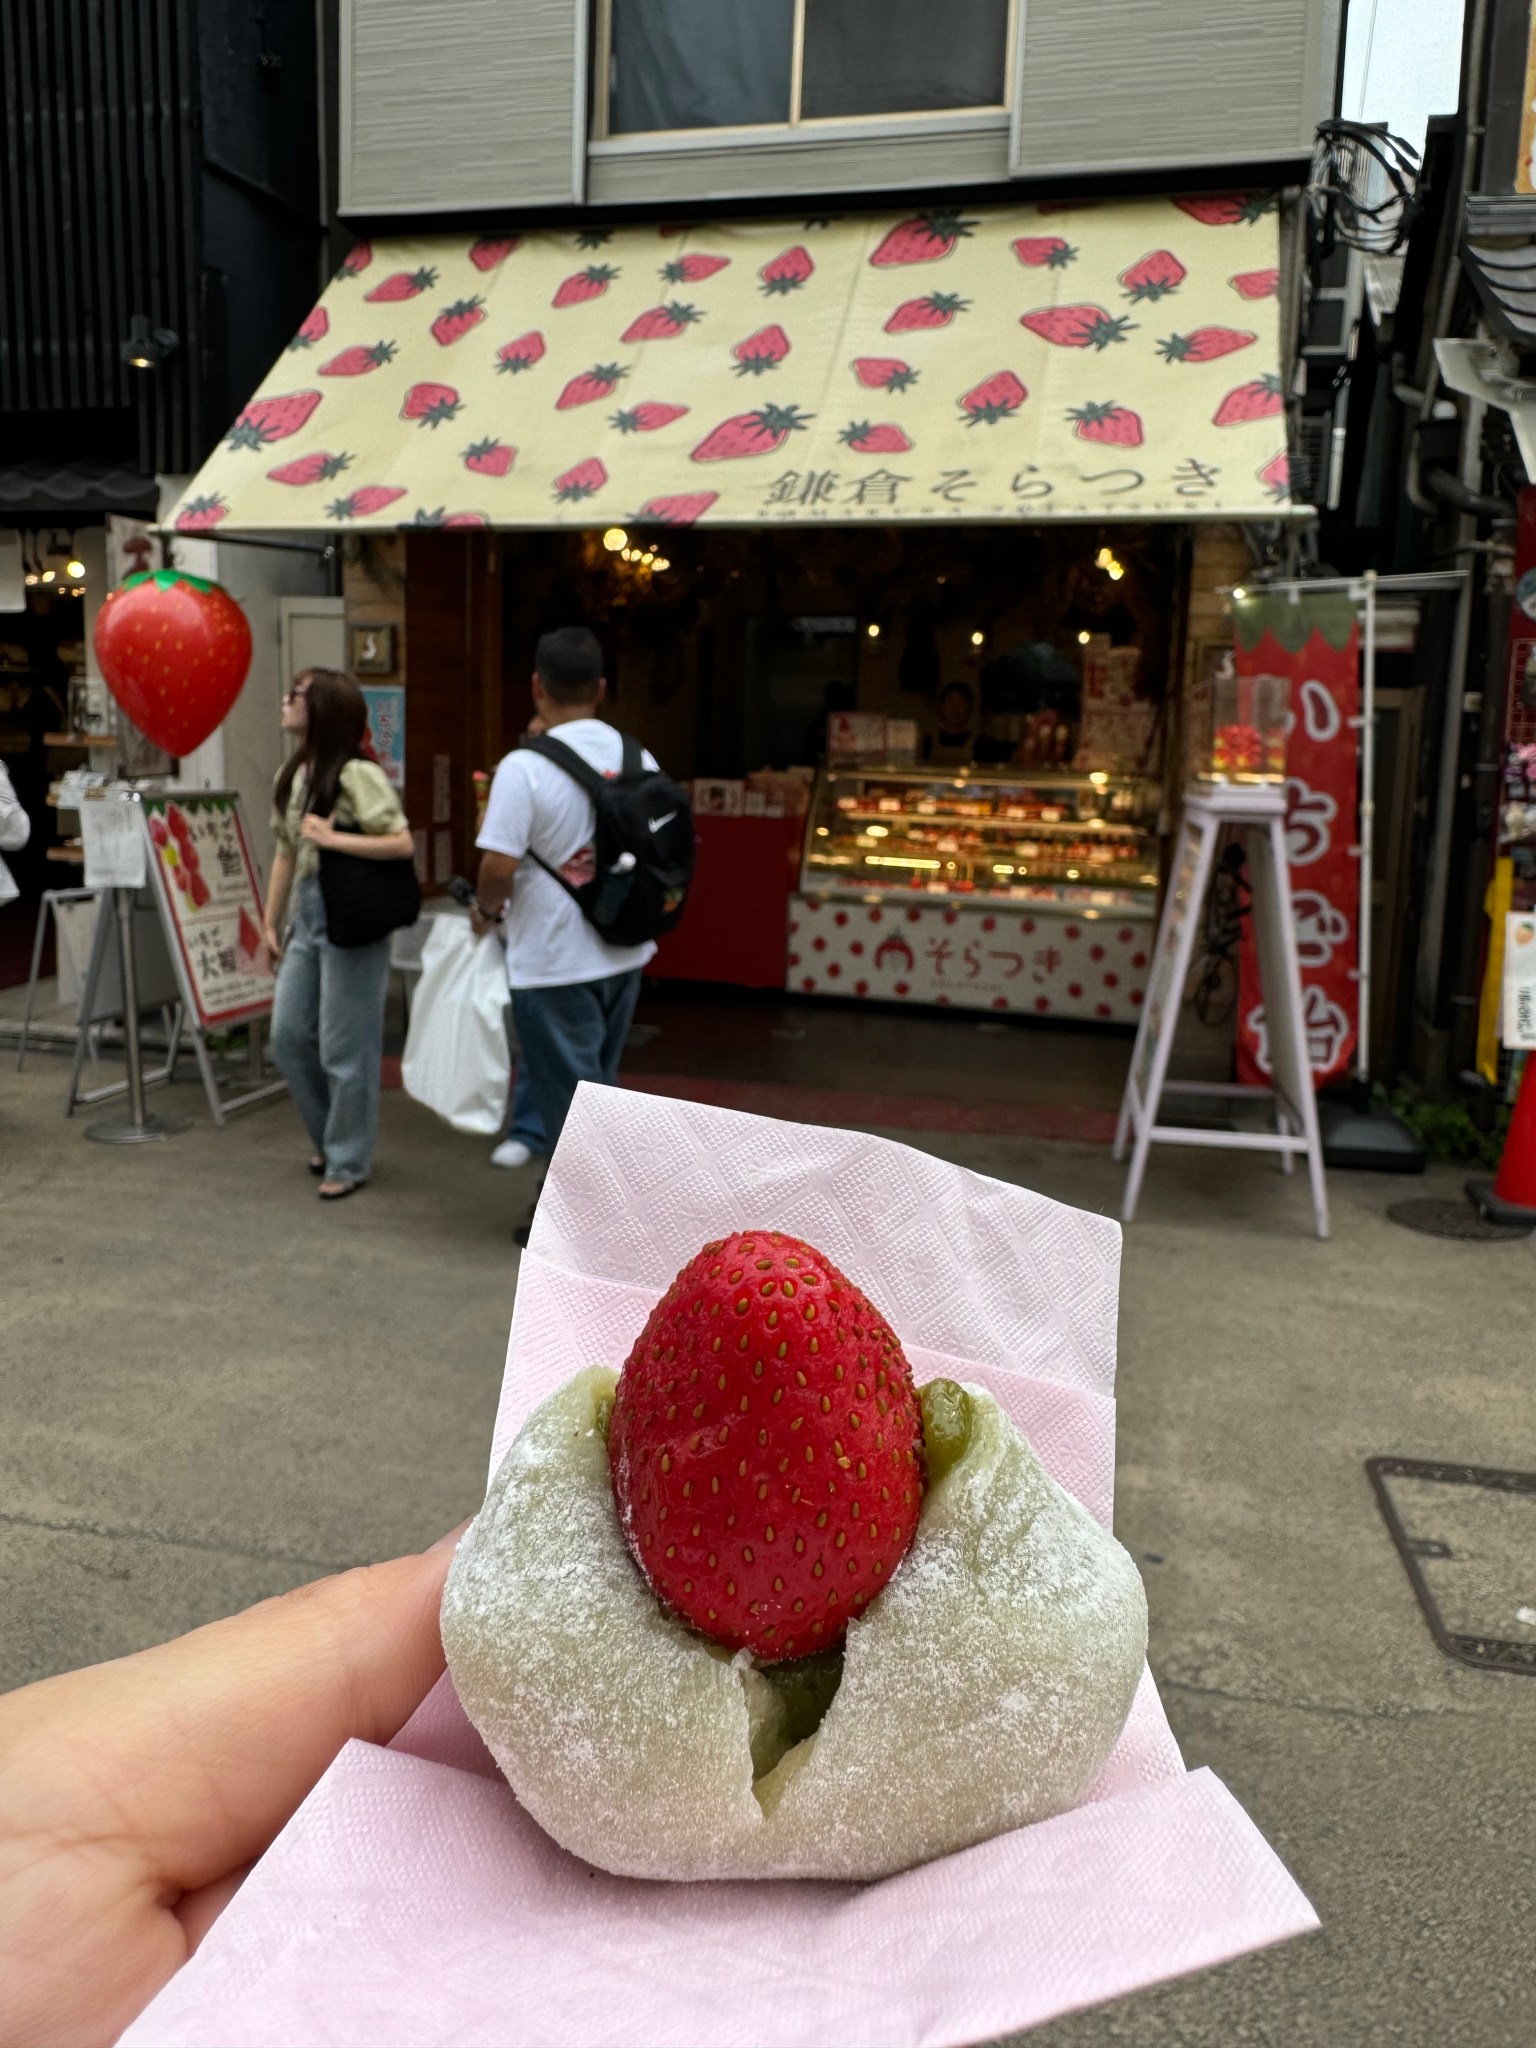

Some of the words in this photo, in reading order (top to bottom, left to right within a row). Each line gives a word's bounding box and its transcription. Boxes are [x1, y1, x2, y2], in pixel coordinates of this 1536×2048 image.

[762, 457, 1222, 505] 鎌倉そらつき
[924, 936, 1064, 985] そらつき
